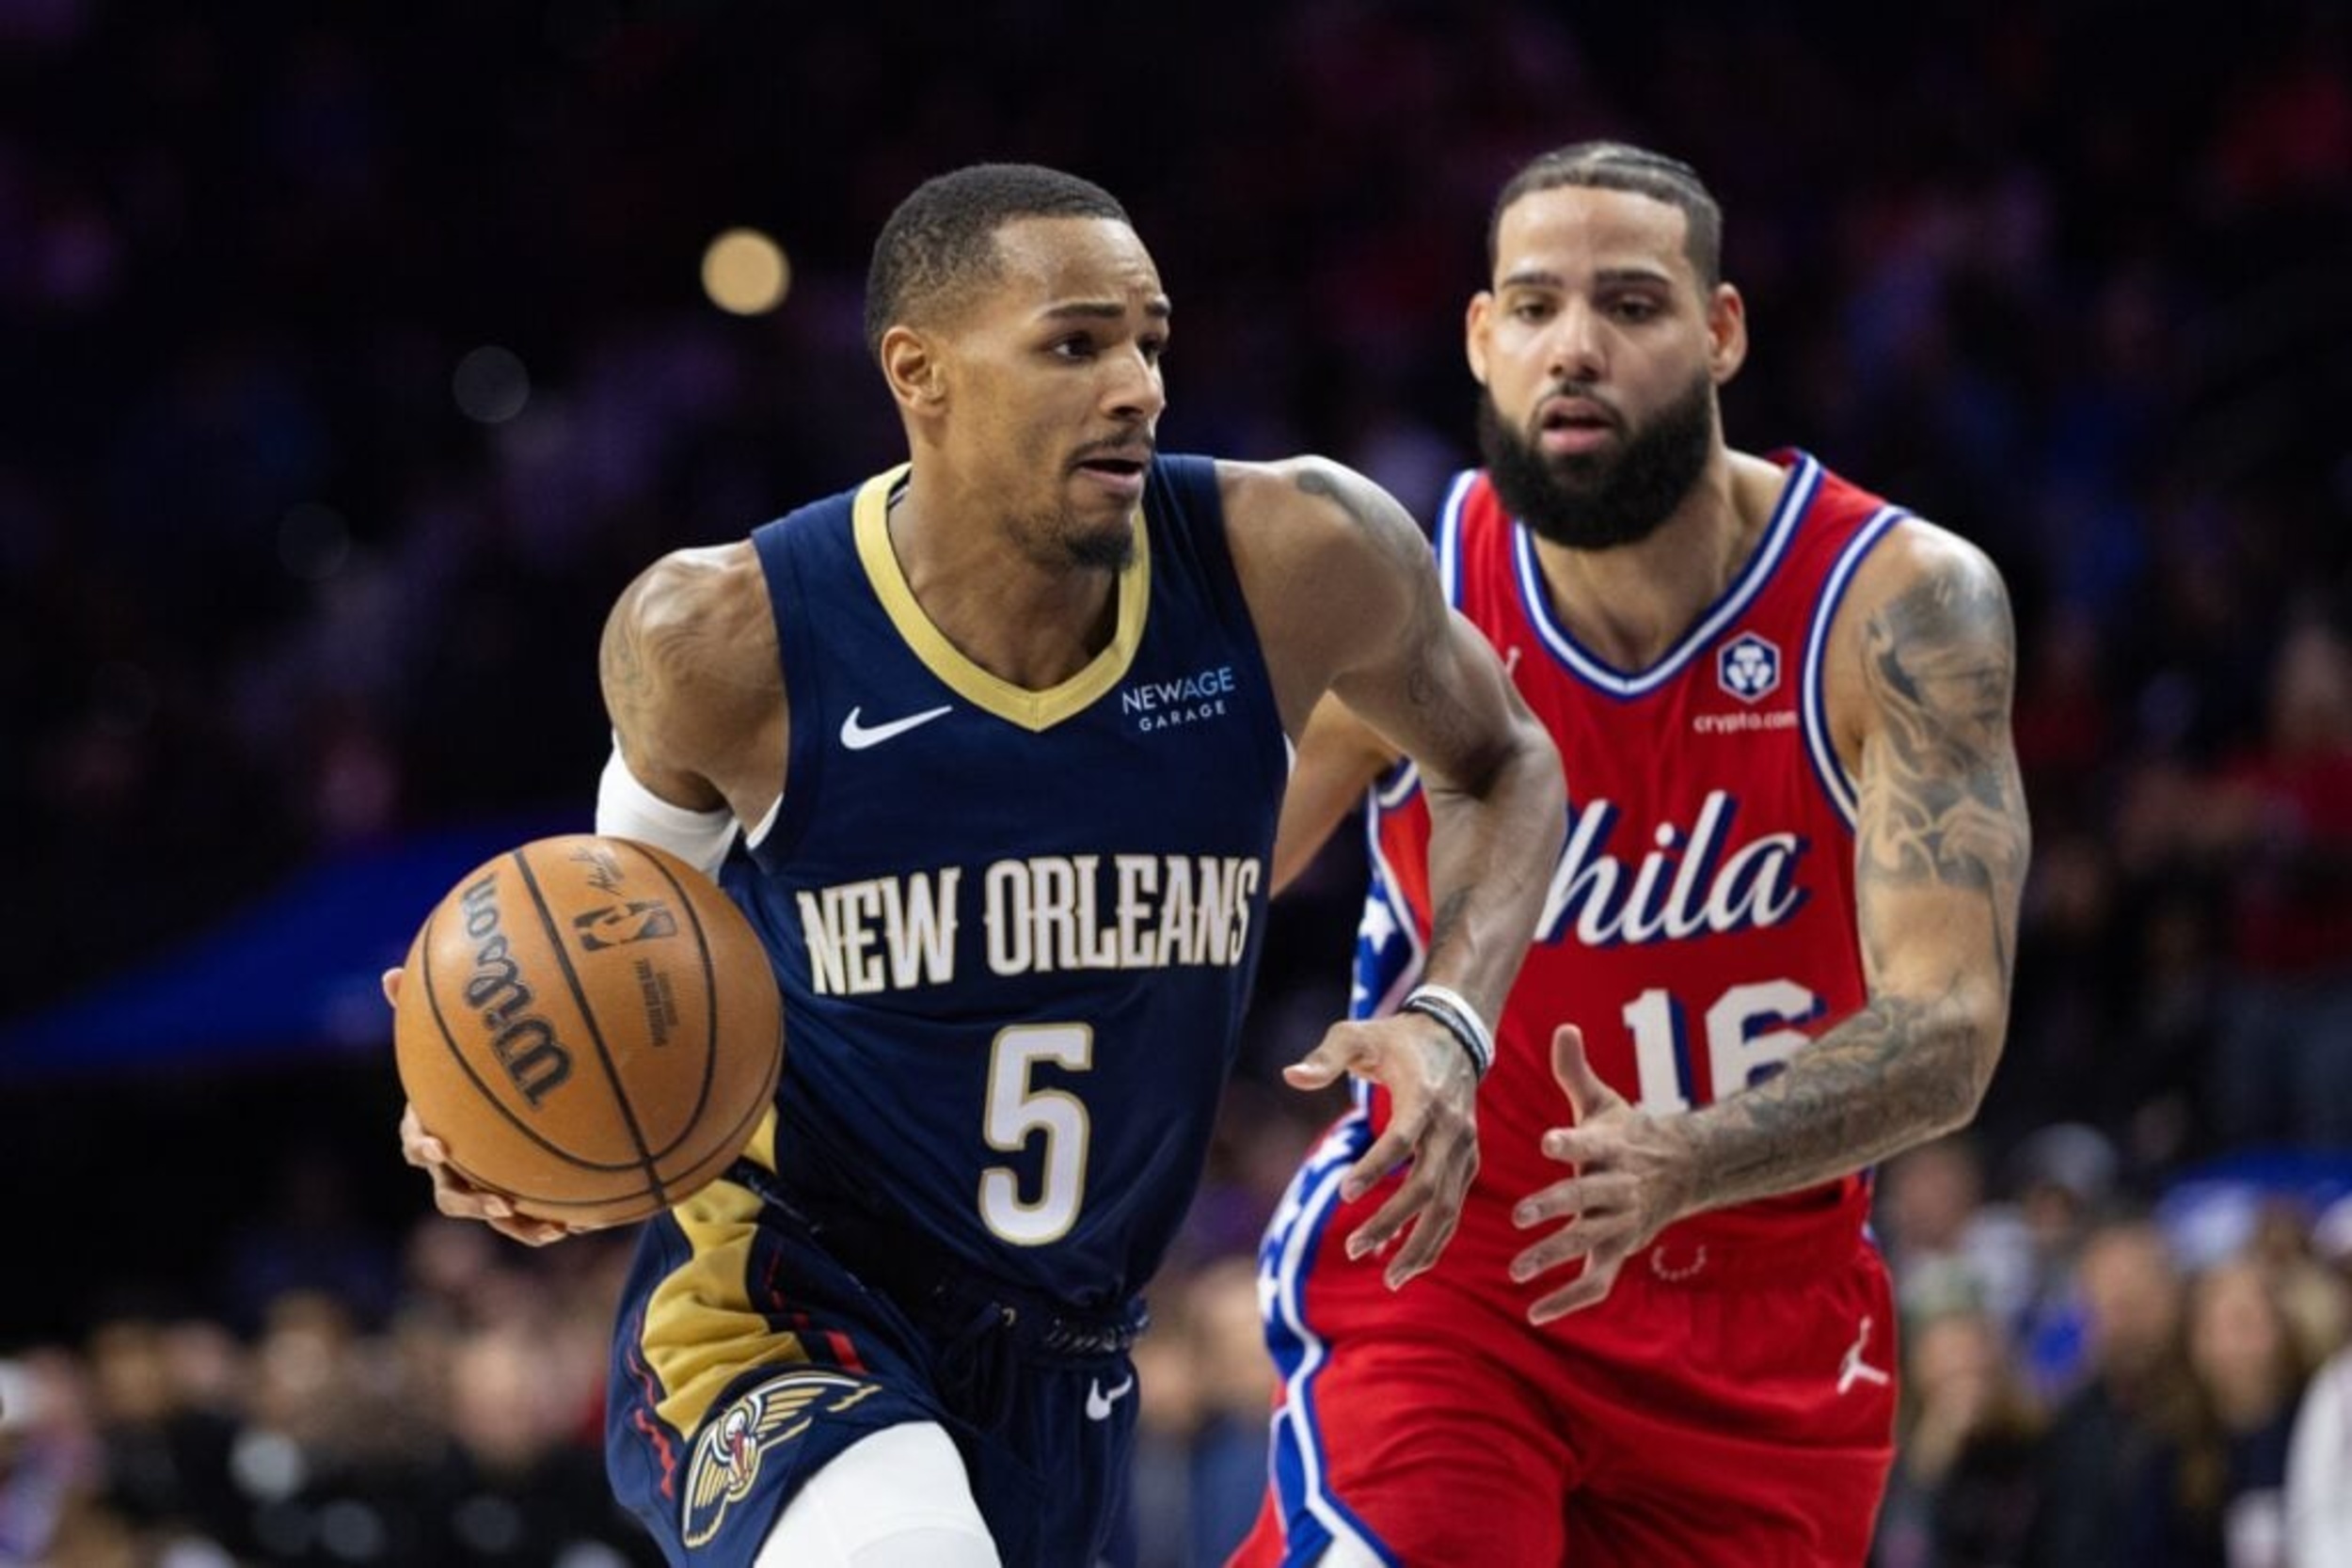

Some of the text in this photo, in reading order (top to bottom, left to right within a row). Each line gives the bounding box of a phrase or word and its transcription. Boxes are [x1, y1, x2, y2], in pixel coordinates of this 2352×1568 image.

[1138, 700, 1226, 732] GARAGE
[797, 855, 1261, 995] NEW ORLEANS
[1534, 790, 1810, 946] hila
[458, 873, 574, 1110] Wilson
[1623, 978, 1828, 1116] 16
[978, 1022, 1093, 1246] 5
